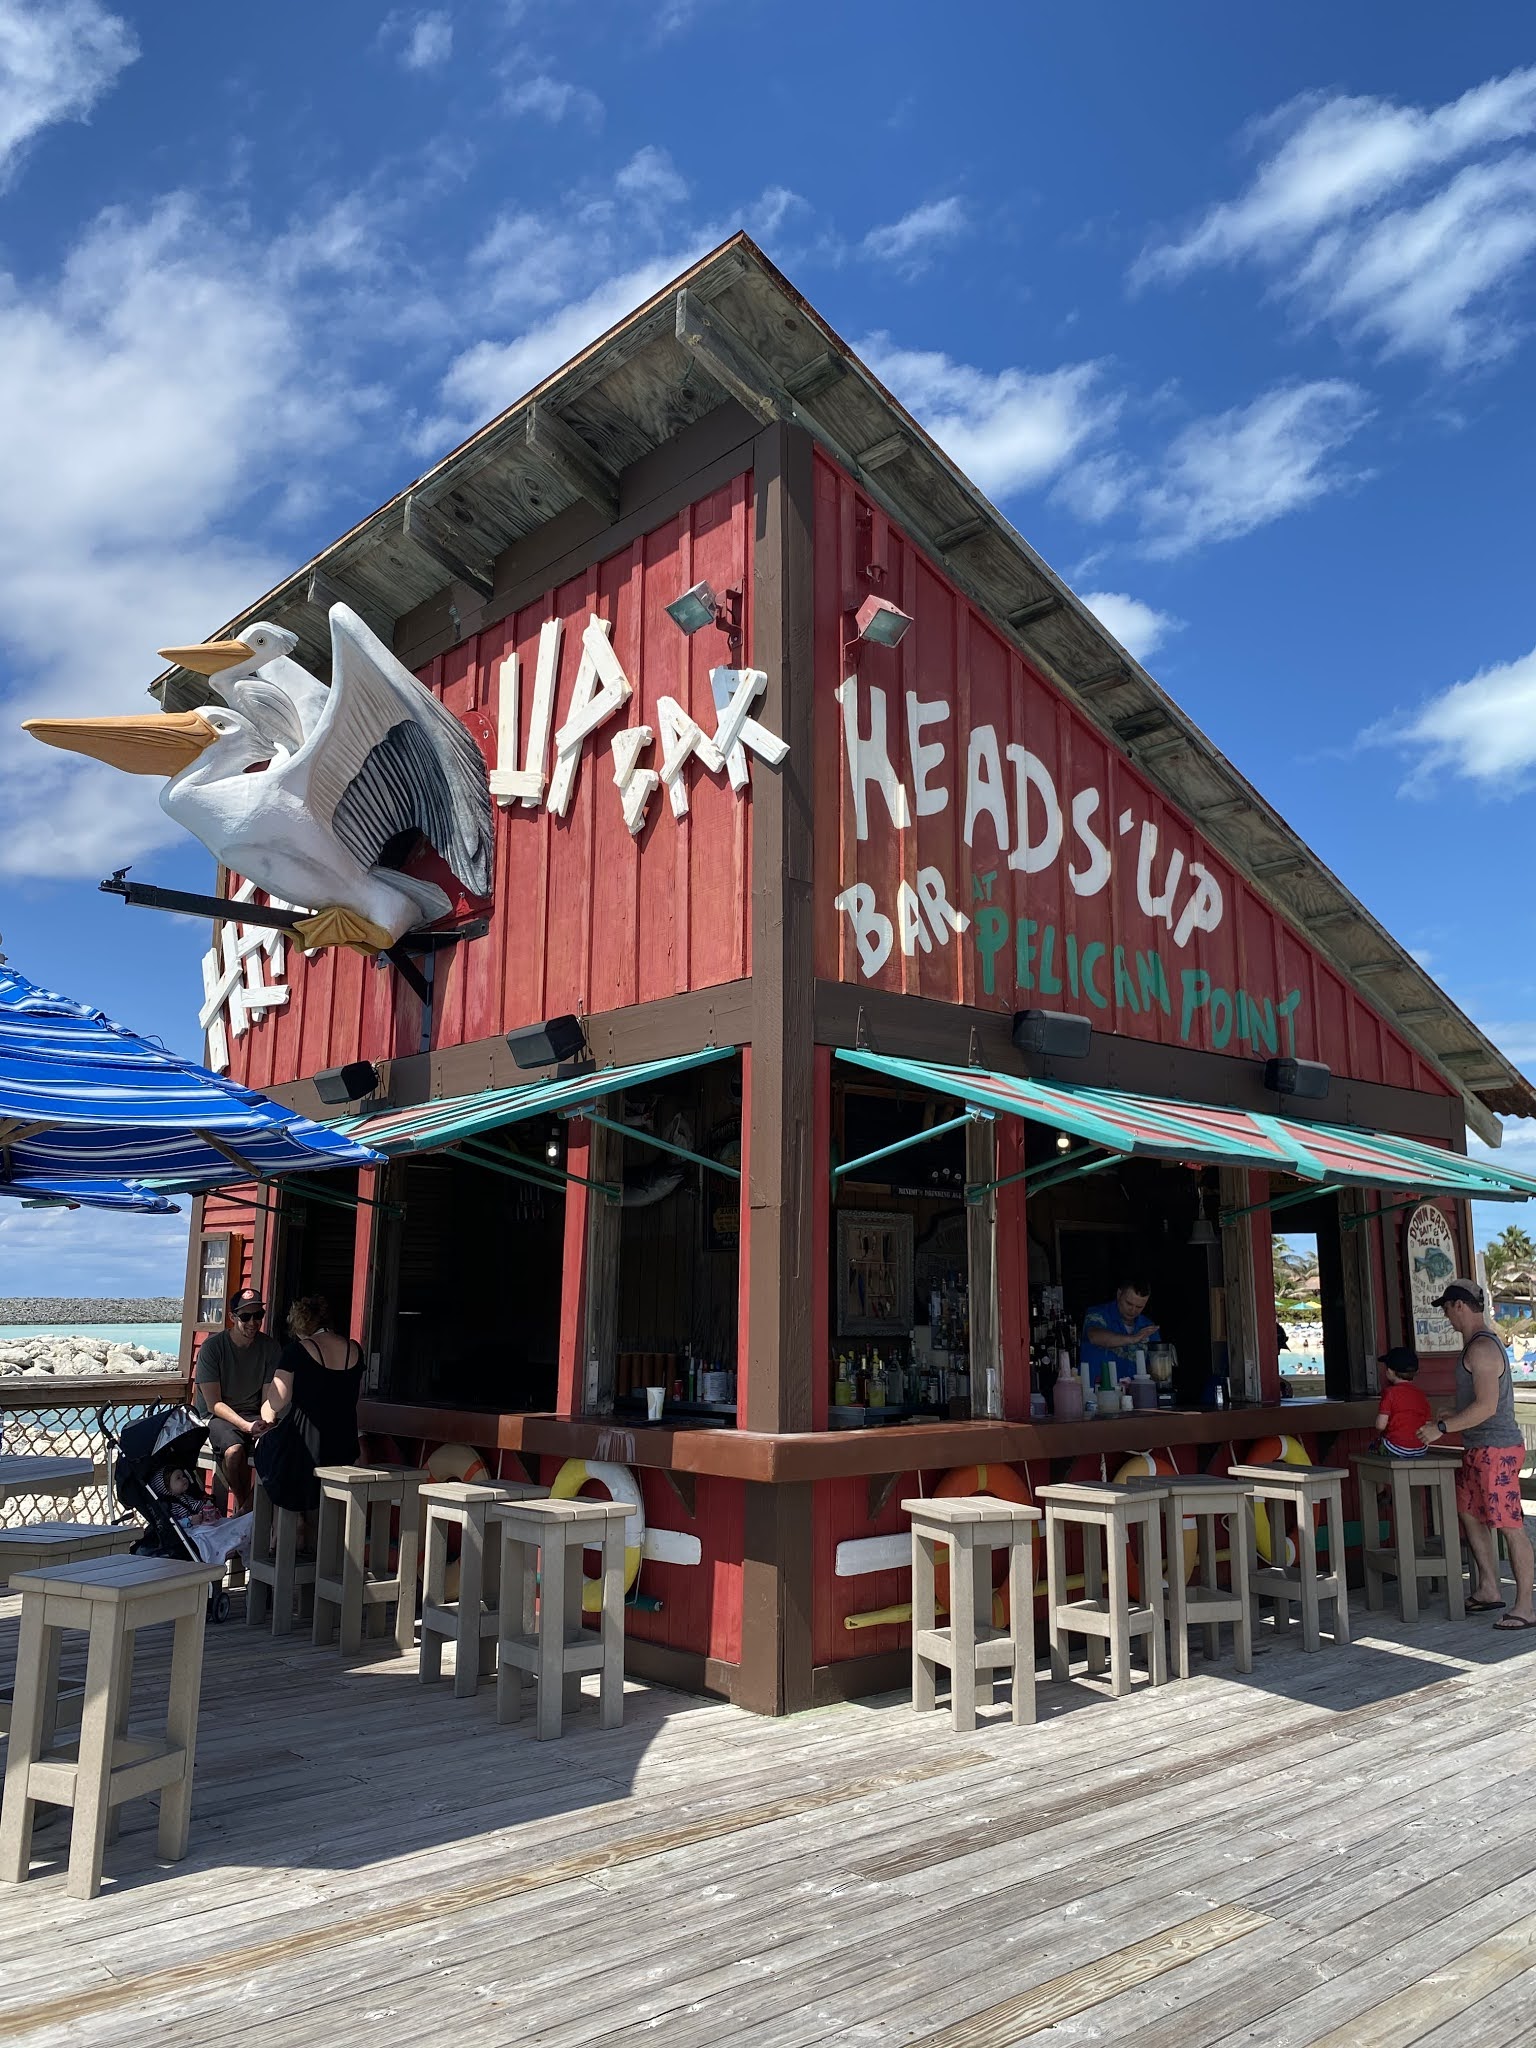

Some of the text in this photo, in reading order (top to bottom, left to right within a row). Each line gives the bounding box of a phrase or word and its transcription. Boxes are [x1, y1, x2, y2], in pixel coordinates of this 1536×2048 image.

[489, 612, 633, 819] UP
[973, 871, 998, 901] AT
[834, 865, 971, 979] BAR
[974, 906, 1301, 1056] PELICAN POINT
[1410, 1206, 1451, 1241] DOWN EAST
[1419, 1223, 1433, 1237] BAIT
[1417, 1237, 1440, 1248] TACKLE
